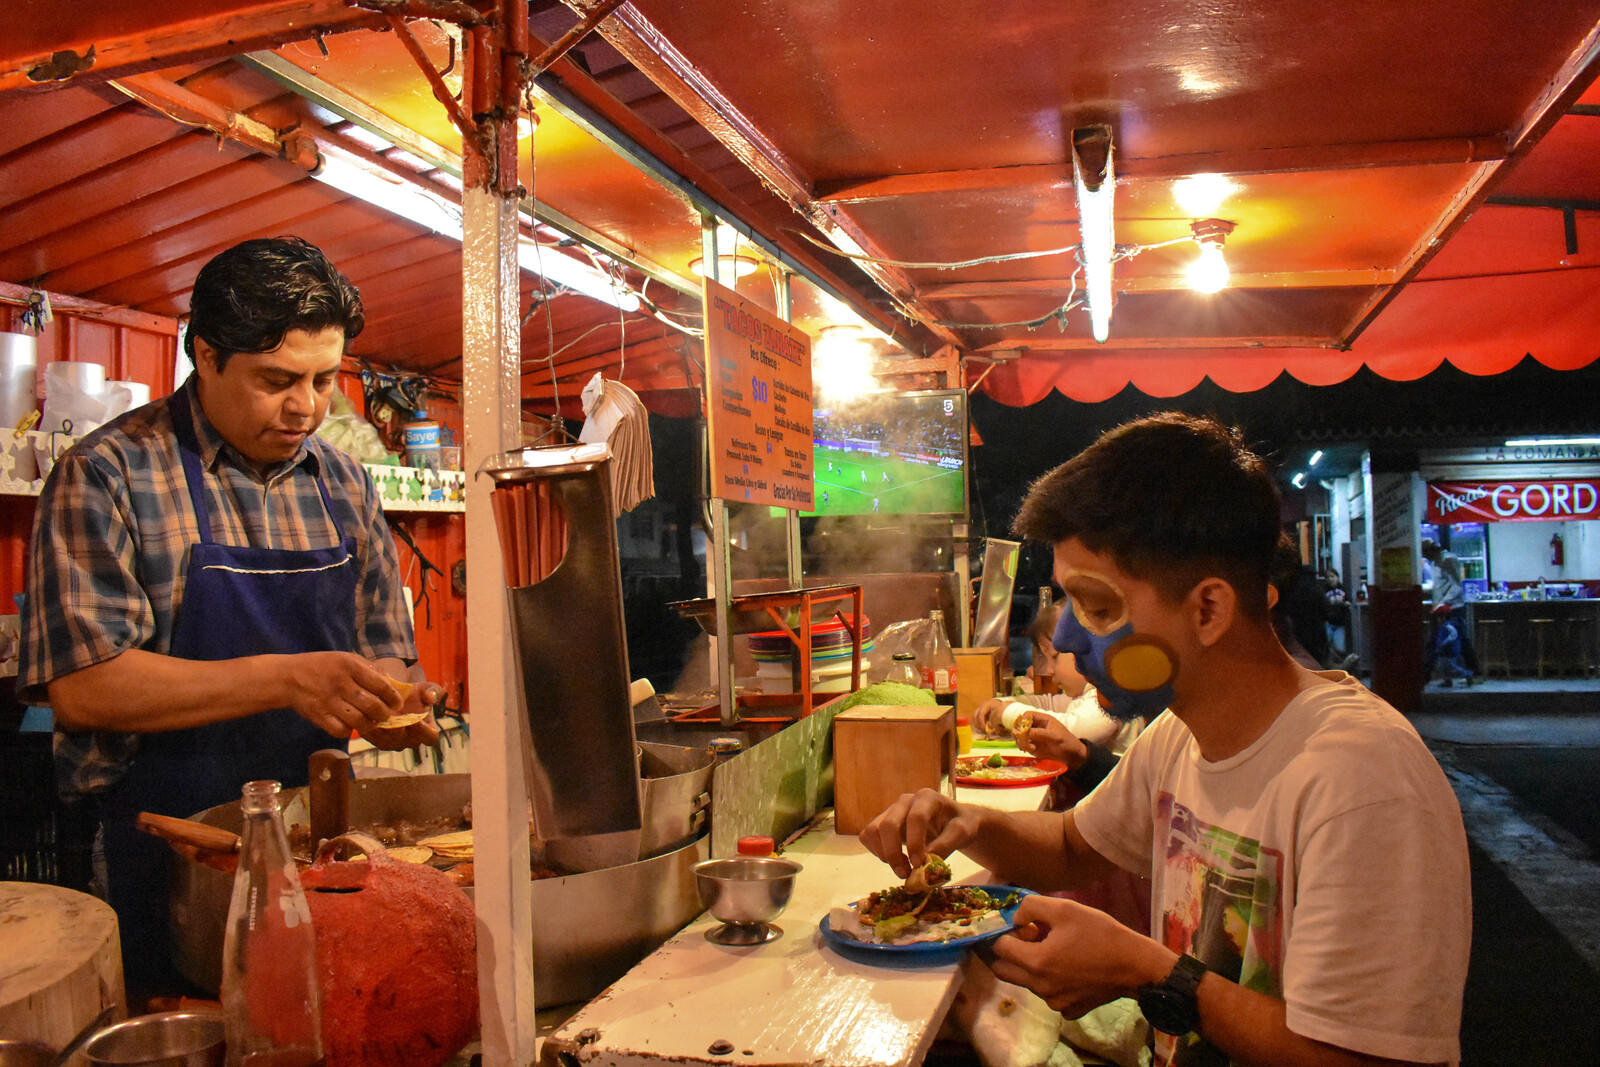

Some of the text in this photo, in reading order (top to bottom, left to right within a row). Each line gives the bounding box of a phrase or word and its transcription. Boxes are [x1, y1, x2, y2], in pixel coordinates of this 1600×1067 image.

[752, 375, 768, 403] $10
[944, 399, 954, 412] 5
[406, 431, 436, 443] Sayer
[1492, 483, 1598, 516] GORD
